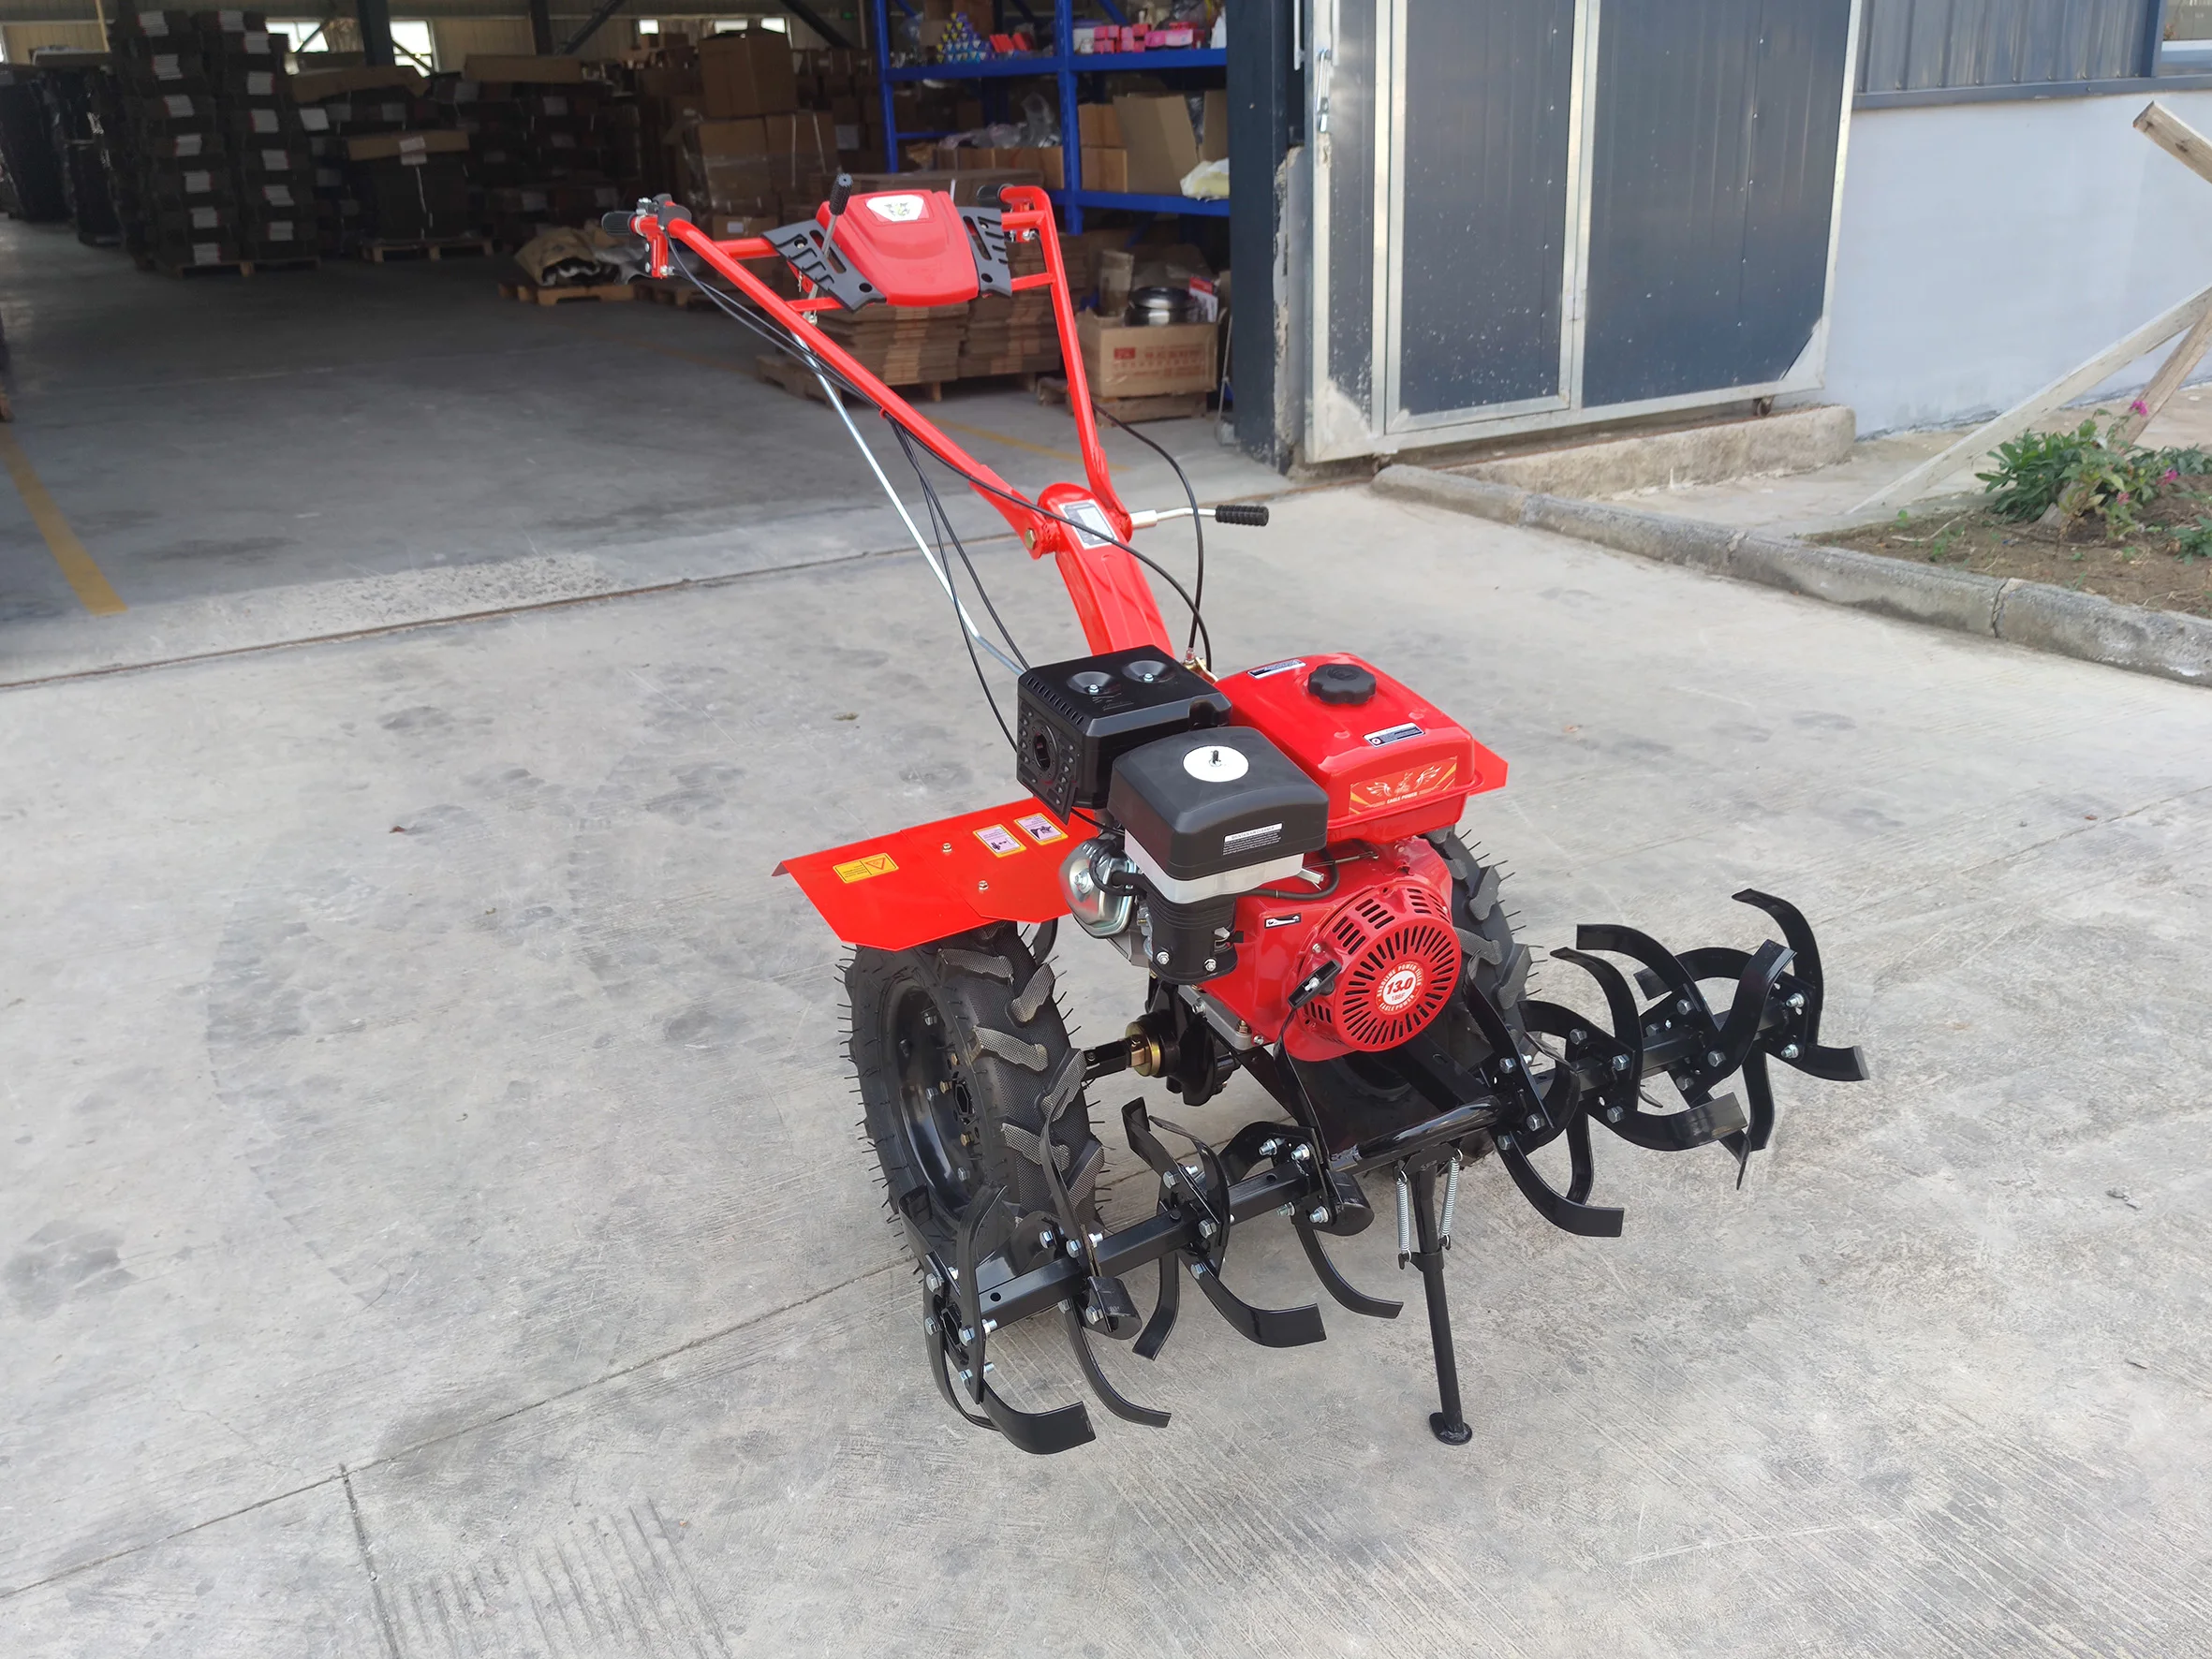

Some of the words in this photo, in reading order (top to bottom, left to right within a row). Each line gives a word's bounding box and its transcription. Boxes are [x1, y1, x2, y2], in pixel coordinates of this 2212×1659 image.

[1401, 791, 1418, 800] POWER
[1377, 969, 1396, 997] GASOLINE
[1397, 963, 1417, 972] POWER
[1386, 976, 1414, 995] 13.0
[1379, 1002, 1395, 1011] EAGLE
[1395, 993, 1415, 1010] POWER
